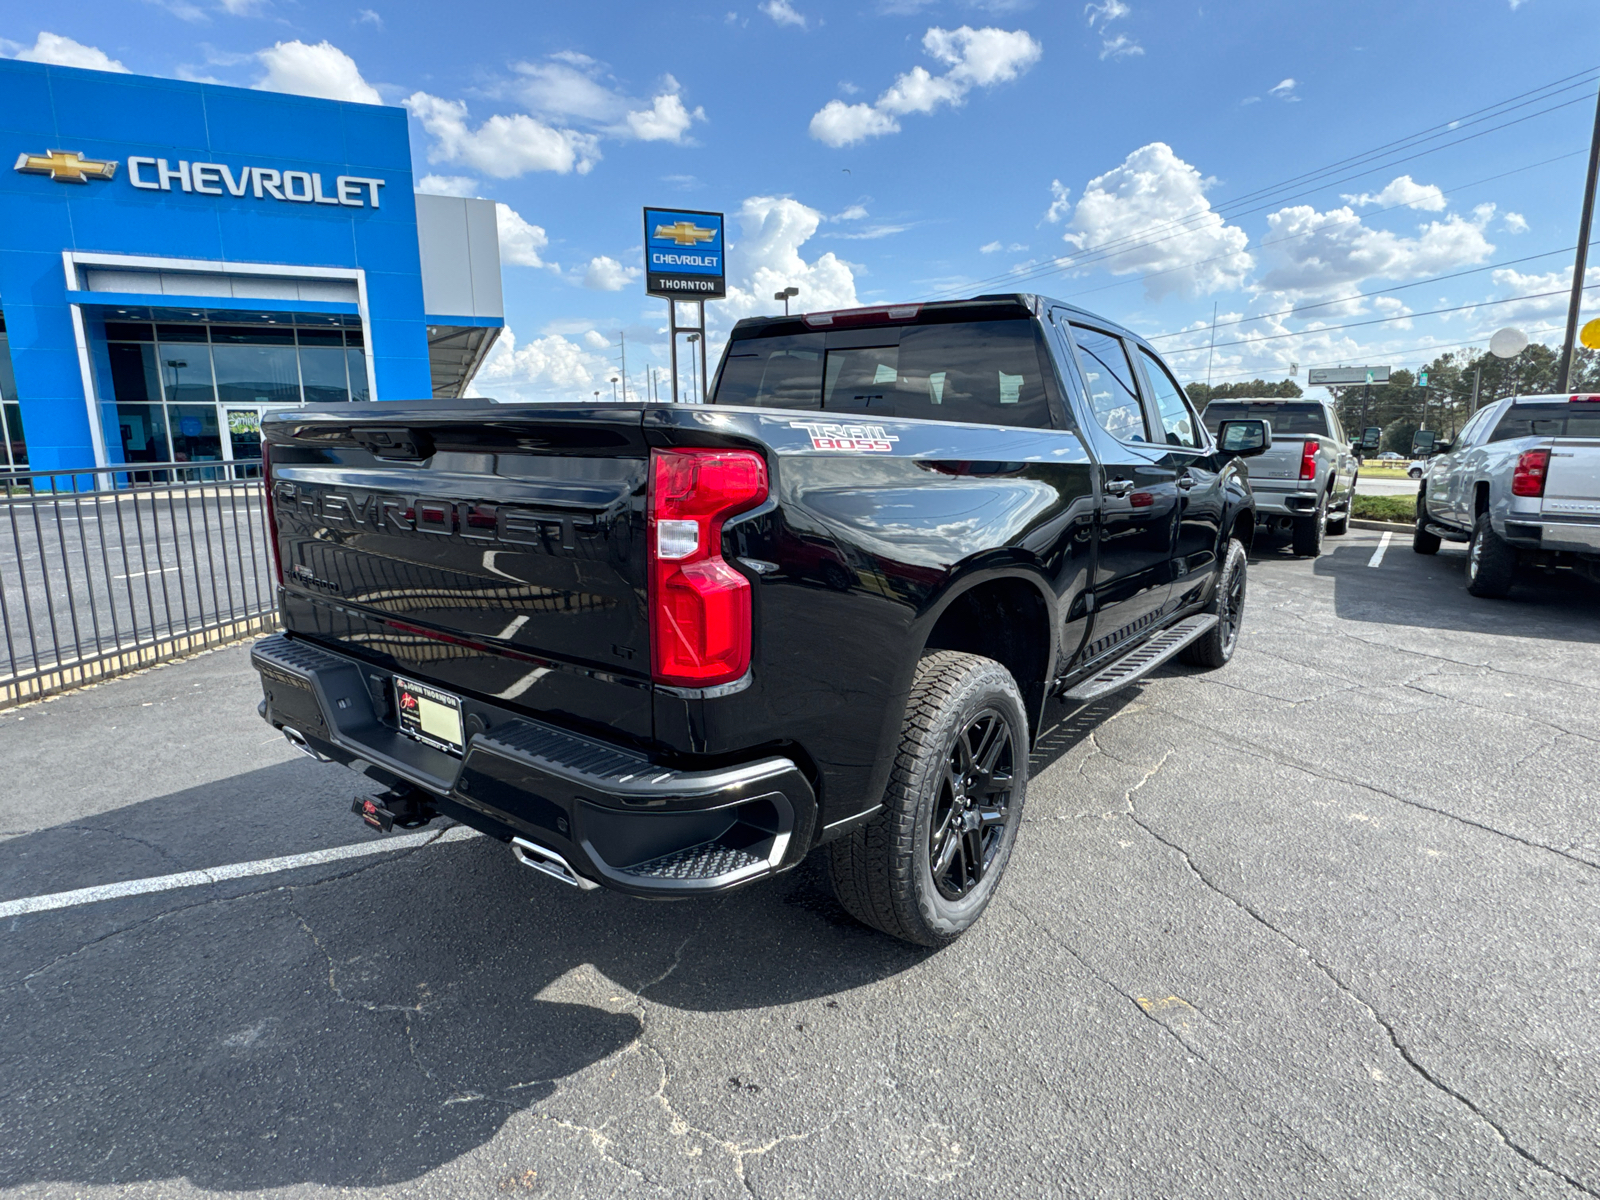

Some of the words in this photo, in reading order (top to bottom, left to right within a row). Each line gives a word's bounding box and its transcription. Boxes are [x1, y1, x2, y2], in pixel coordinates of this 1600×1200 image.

[127, 156, 385, 208] CHEVROLET
[653, 253, 718, 267] CHEVROLET
[659, 279, 715, 291] THORNTON
[789, 421, 900, 441] TRAIL
[812, 438, 893, 452] BOSS
[275, 482, 594, 550] CHEVROLET
[610, 643, 637, 660] LT
[406, 682, 424, 695] JOHN
[423, 687, 457, 707] THORNTON
